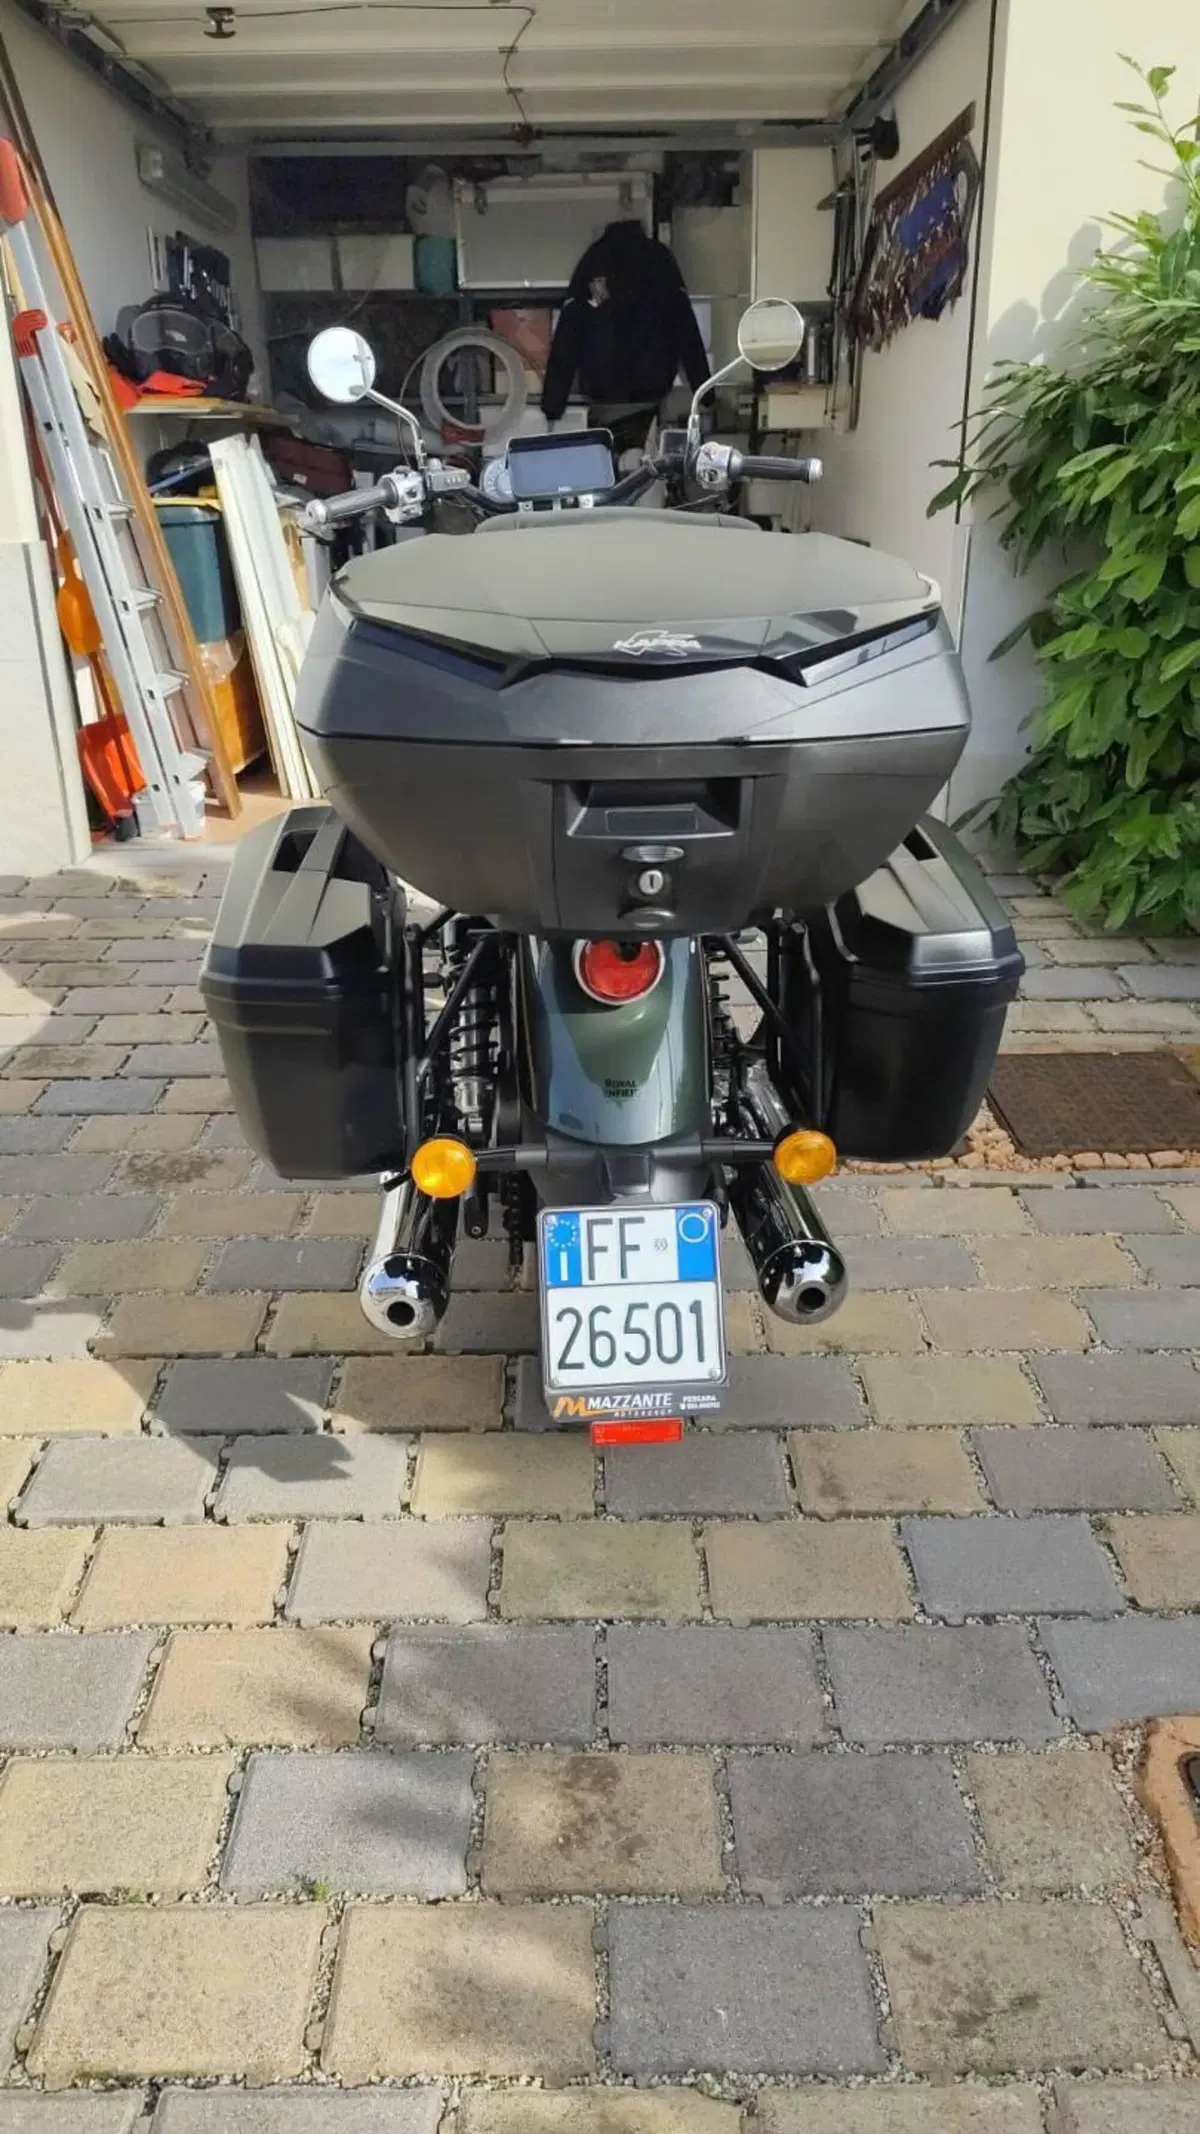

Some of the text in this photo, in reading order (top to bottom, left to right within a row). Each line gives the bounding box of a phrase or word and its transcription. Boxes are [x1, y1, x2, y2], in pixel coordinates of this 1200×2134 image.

[586, 1217, 645, 1281] FF
[556, 1299, 705, 1370] 26501
[588, 1393, 674, 1409] MAZZANTE
